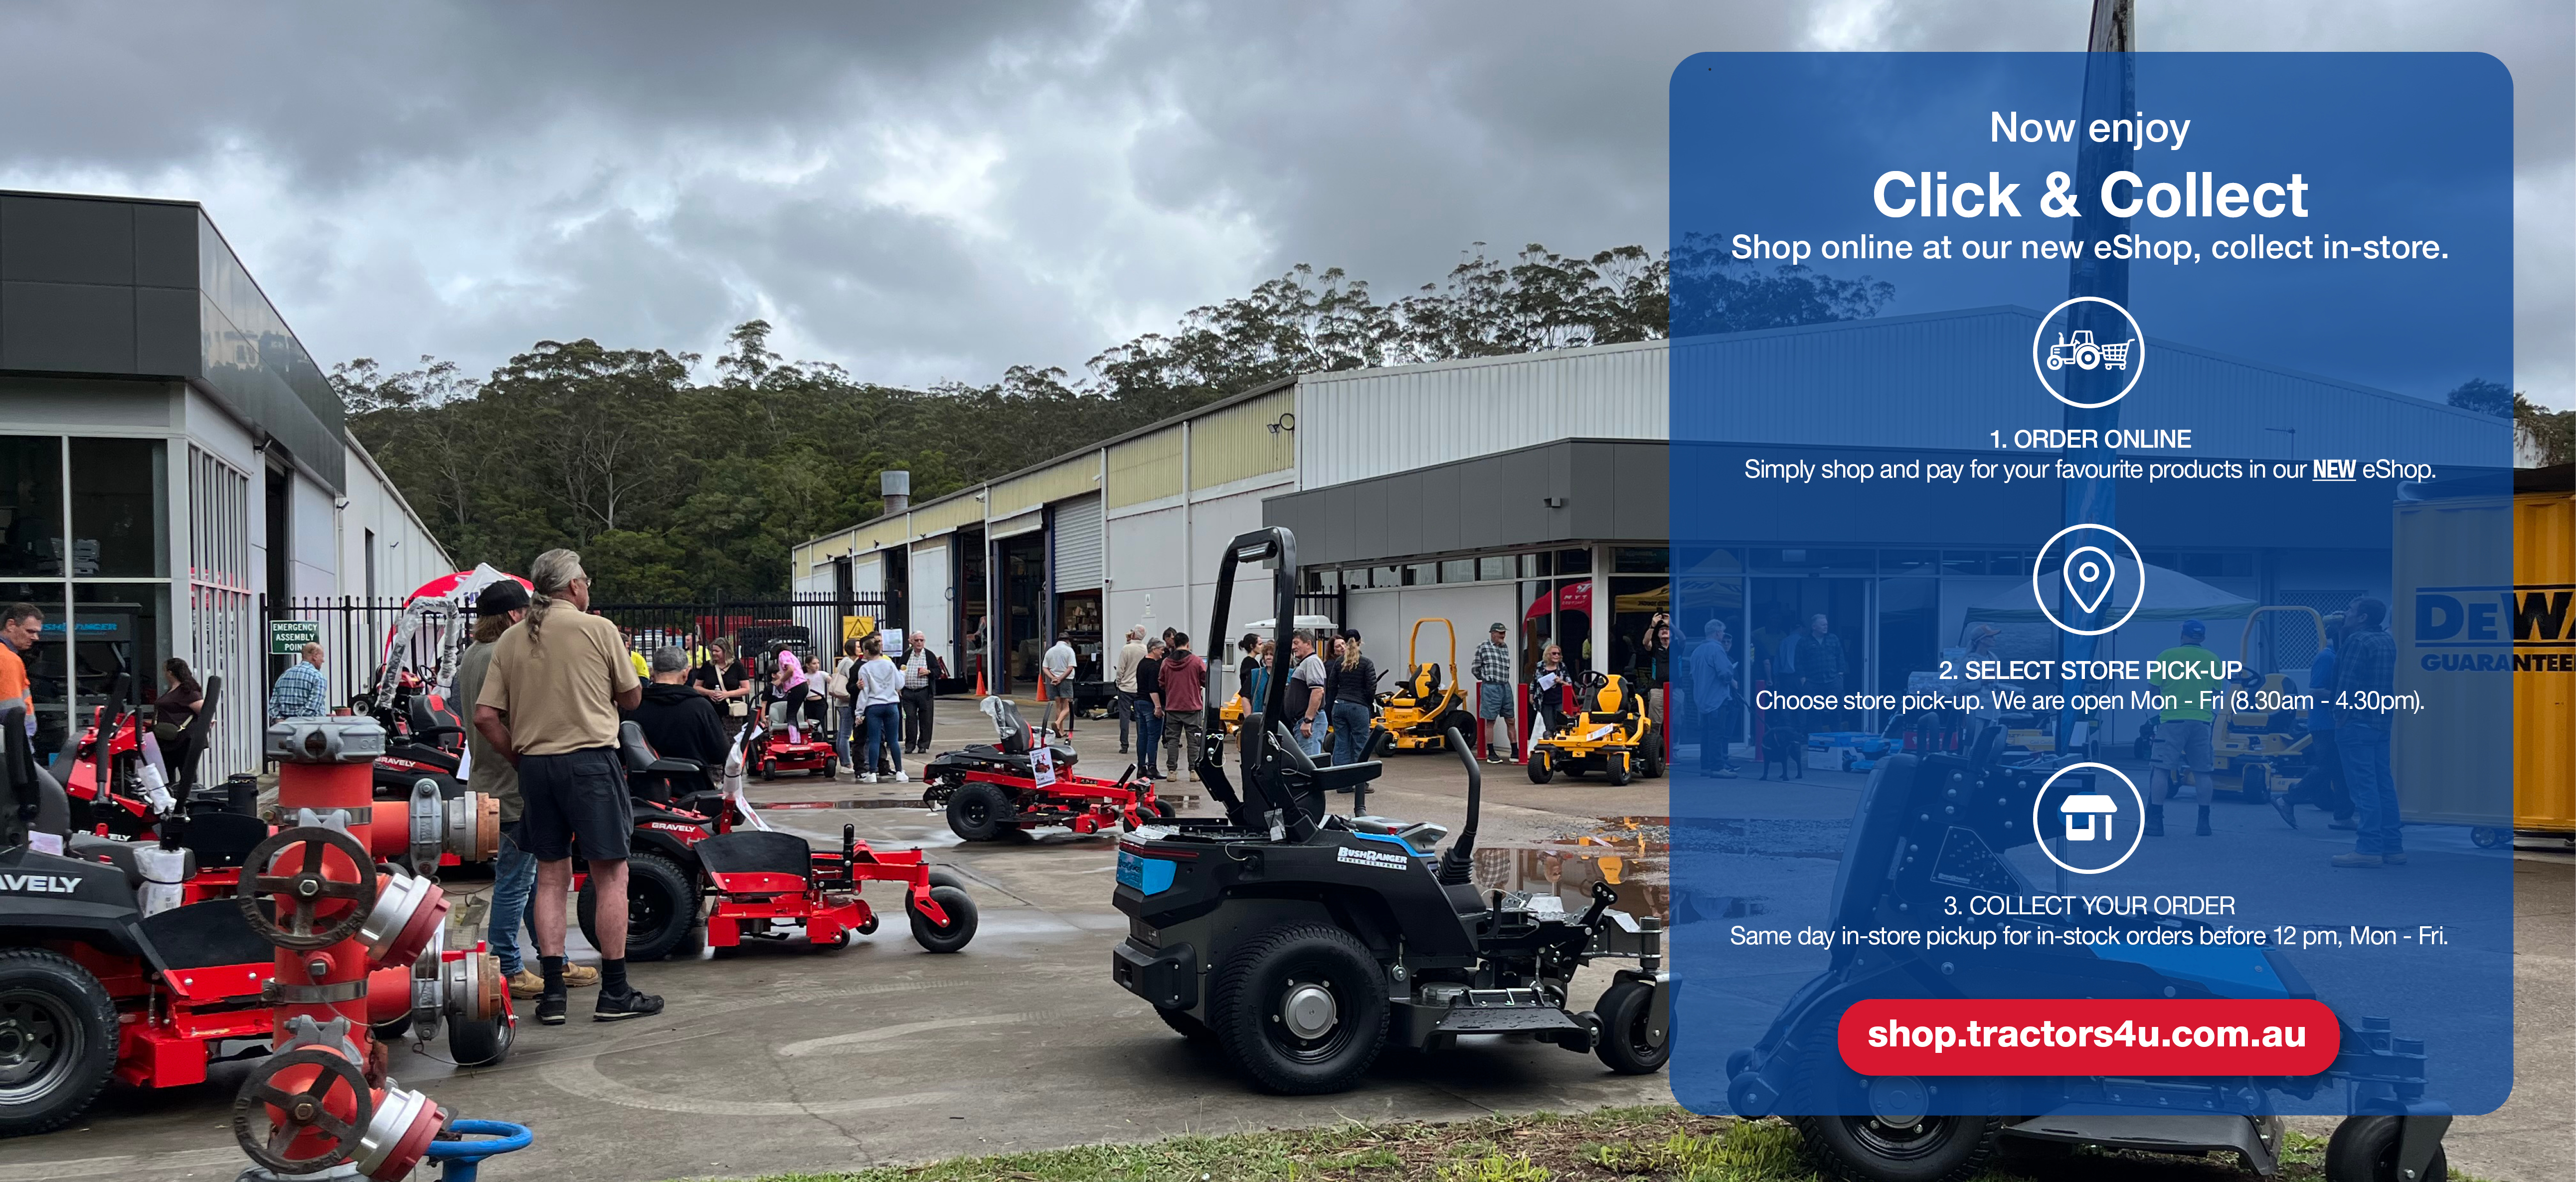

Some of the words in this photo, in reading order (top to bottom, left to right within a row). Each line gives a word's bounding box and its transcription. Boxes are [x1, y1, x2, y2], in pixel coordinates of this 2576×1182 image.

[2415, 592, 2576, 640] DEW
[2420, 654, 2576, 672] GUARANTEE
[652, 822, 696, 833] GRAVELY
[1338, 846, 1407, 864] BUSHRANGER
[1365, 860, 1404, 869] EQUIPMENT
